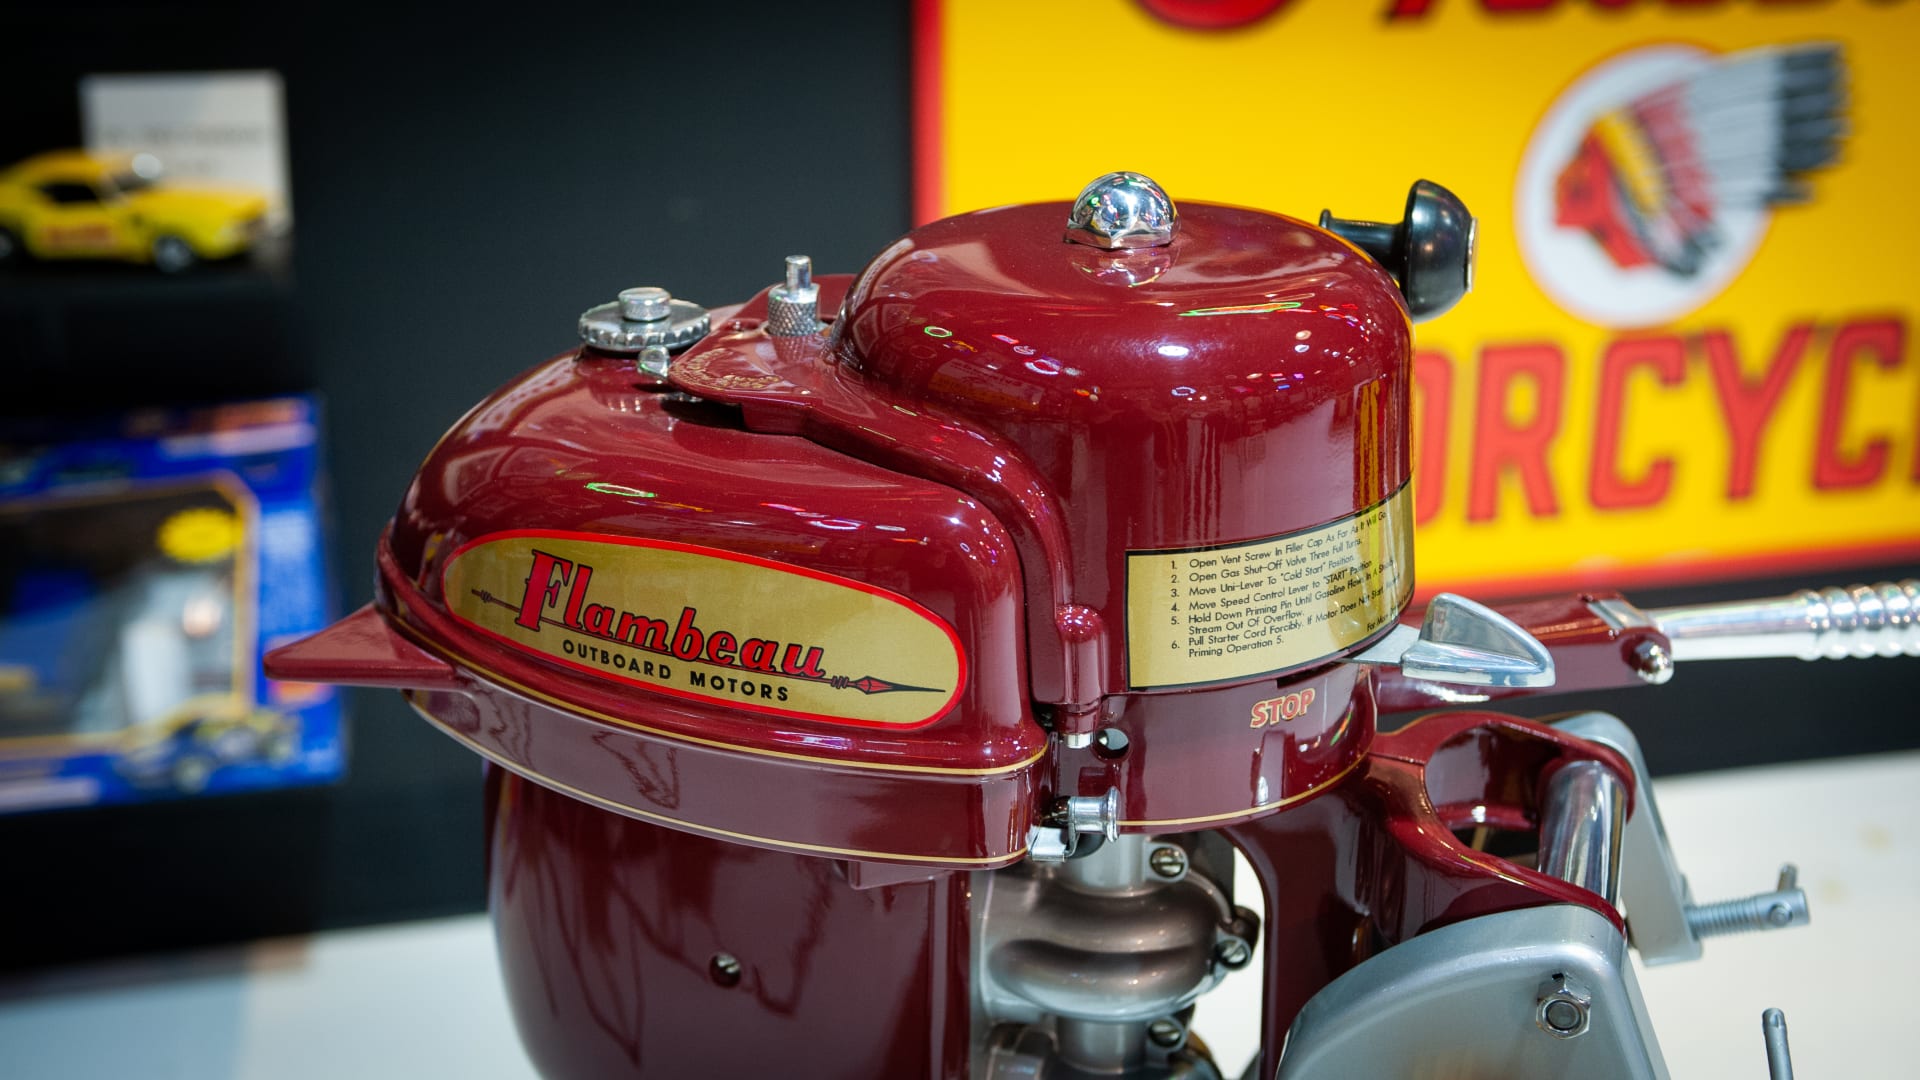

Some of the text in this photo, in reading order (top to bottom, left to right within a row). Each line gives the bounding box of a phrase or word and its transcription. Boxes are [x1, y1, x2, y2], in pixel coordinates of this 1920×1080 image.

[1415, 317, 1920, 527] RCYC
[1171, 560, 1178, 570] 1.
[1189, 558, 1217, 569] Open
[1221, 555, 1241, 565] Vent
[1245, 552, 1272, 562] Screw
[1275, 547, 1283, 556] In
[1286, 542, 1304, 554] Filler
[1307, 538, 1323, 548] Cap
[1325, 533, 1335, 543] As
[1337, 529, 1348, 539] Far
[1351, 525, 1359, 534] As
[1189, 572, 1217, 583] Open
[1221, 569, 1240, 578] Gas
[1244, 559, 1283, 576] Shut-Off
[1286, 554, 1307, 567] Valve
[1310, 550, 1330, 561] Three
[1333, 542, 1344, 554] Full
[1170, 588, 1180, 598] 3.
[1189, 586, 1217, 596] Move
[1220, 580, 1264, 593] Uni-Lever
[1267, 576, 1277, 585] To
[1280, 569, 1302, 581] "Cold
[1305, 562, 1326, 576] Start"
[1170, 602, 1180, 612] 4.
[1189, 601, 1217, 611] Move
[1220, 593, 1250, 608] Speed
[1253, 587, 1286, 602] Control
[1288, 583, 1309, 595] Lever
[1312, 580, 1320, 589] to
[514, 549, 826, 679] Flambeau
[1170, 616, 1180, 625] 5.
[1188, 611, 1212, 624] Hold
[1215, 611, 1242, 621] Down
[1245, 604, 1278, 616] Priming
[1280, 599, 1292, 610] Pin
[1295, 594, 1312, 606] Until
[1315, 584, 1346, 600] Gasoline
[1189, 611, 1304, 635] Stream Out Of Overflow.
[1171, 640, 1180, 650] 6.
[1188, 635, 1204, 646] Pull
[1208, 633, 1240, 645] Starter
[1243, 626, 1267, 639] Cord
[1307, 615, 1313, 625] If
[1315, 609, 1338, 623] Motor
[1340, 602, 1357, 614] Does
[1188, 635, 1285, 658] Priming Operation 5.
[563, 638, 789, 702] OUTBOARD MOTORS
[1250, 687, 1316, 729] STOP
